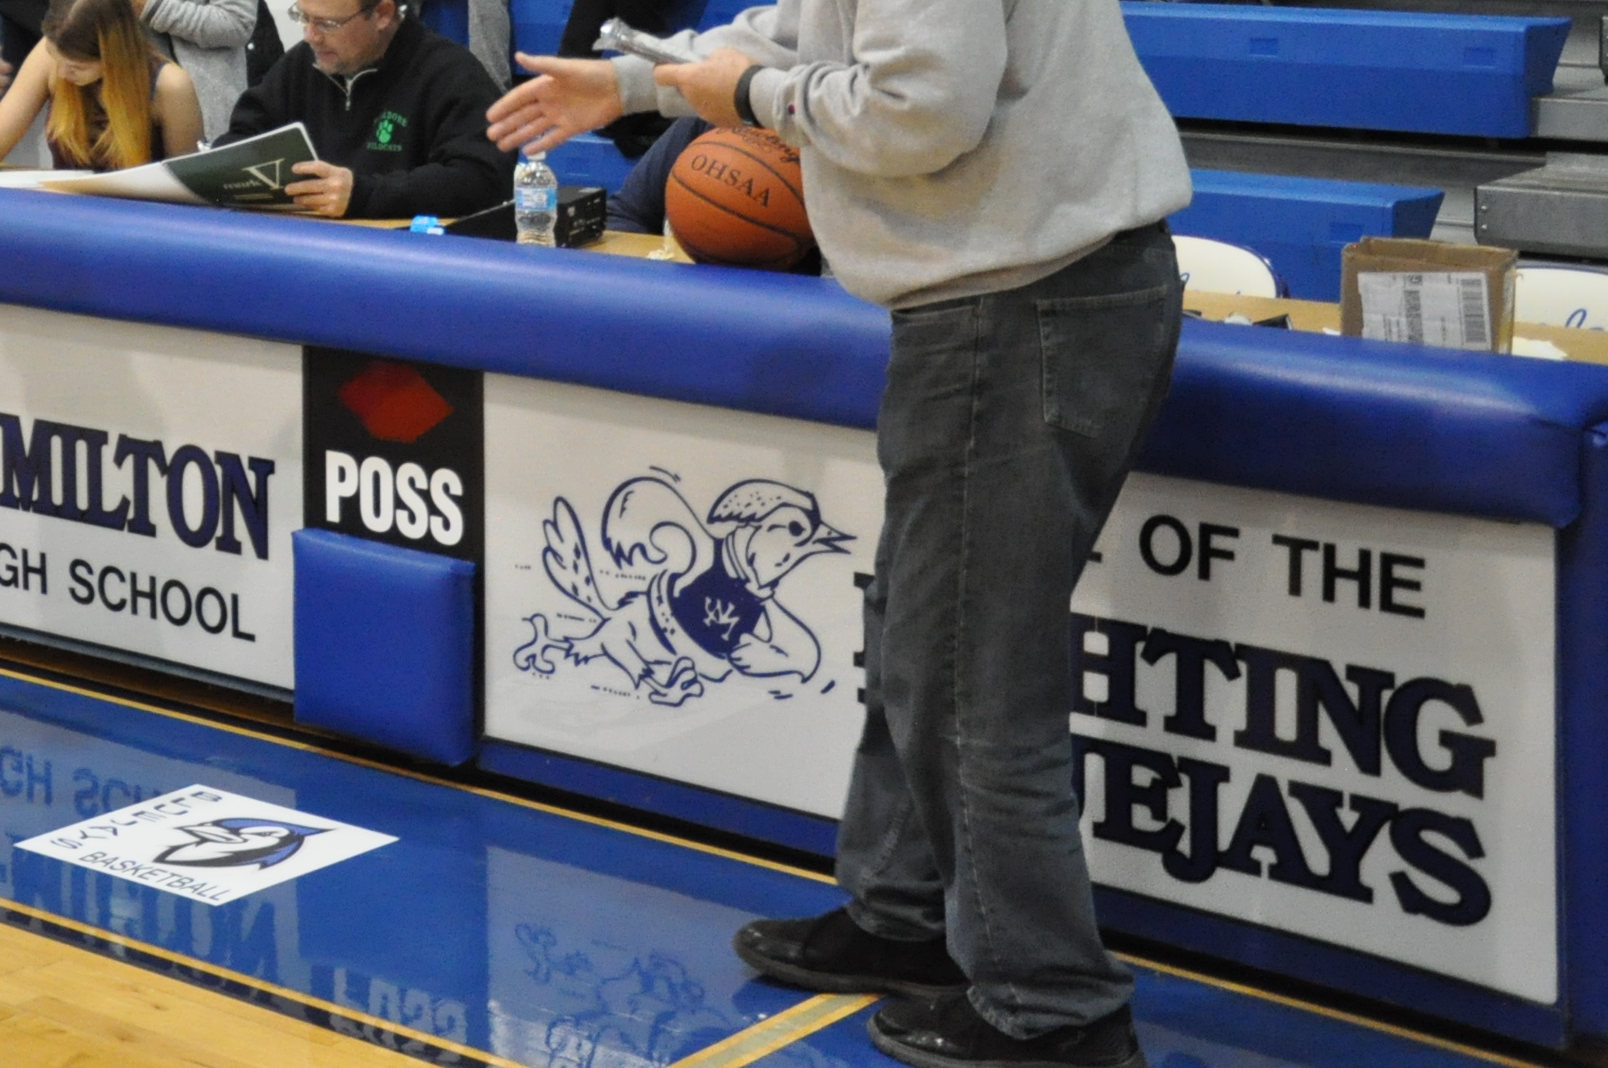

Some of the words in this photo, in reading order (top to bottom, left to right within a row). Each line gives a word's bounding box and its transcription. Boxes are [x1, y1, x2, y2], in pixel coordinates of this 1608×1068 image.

[242, 158, 286, 191] V
[690, 154, 771, 208] OHSAA
[325, 449, 464, 547] POSS
[68, 558, 257, 643] SCHOOL
[1139, 514, 1240, 582] OF
[1272, 534, 1427, 619] THE
[1070, 611, 1497, 800] HTING
[1070, 731, 1492, 926] EJAYS
[78, 850, 233, 902] BASKETBALL
